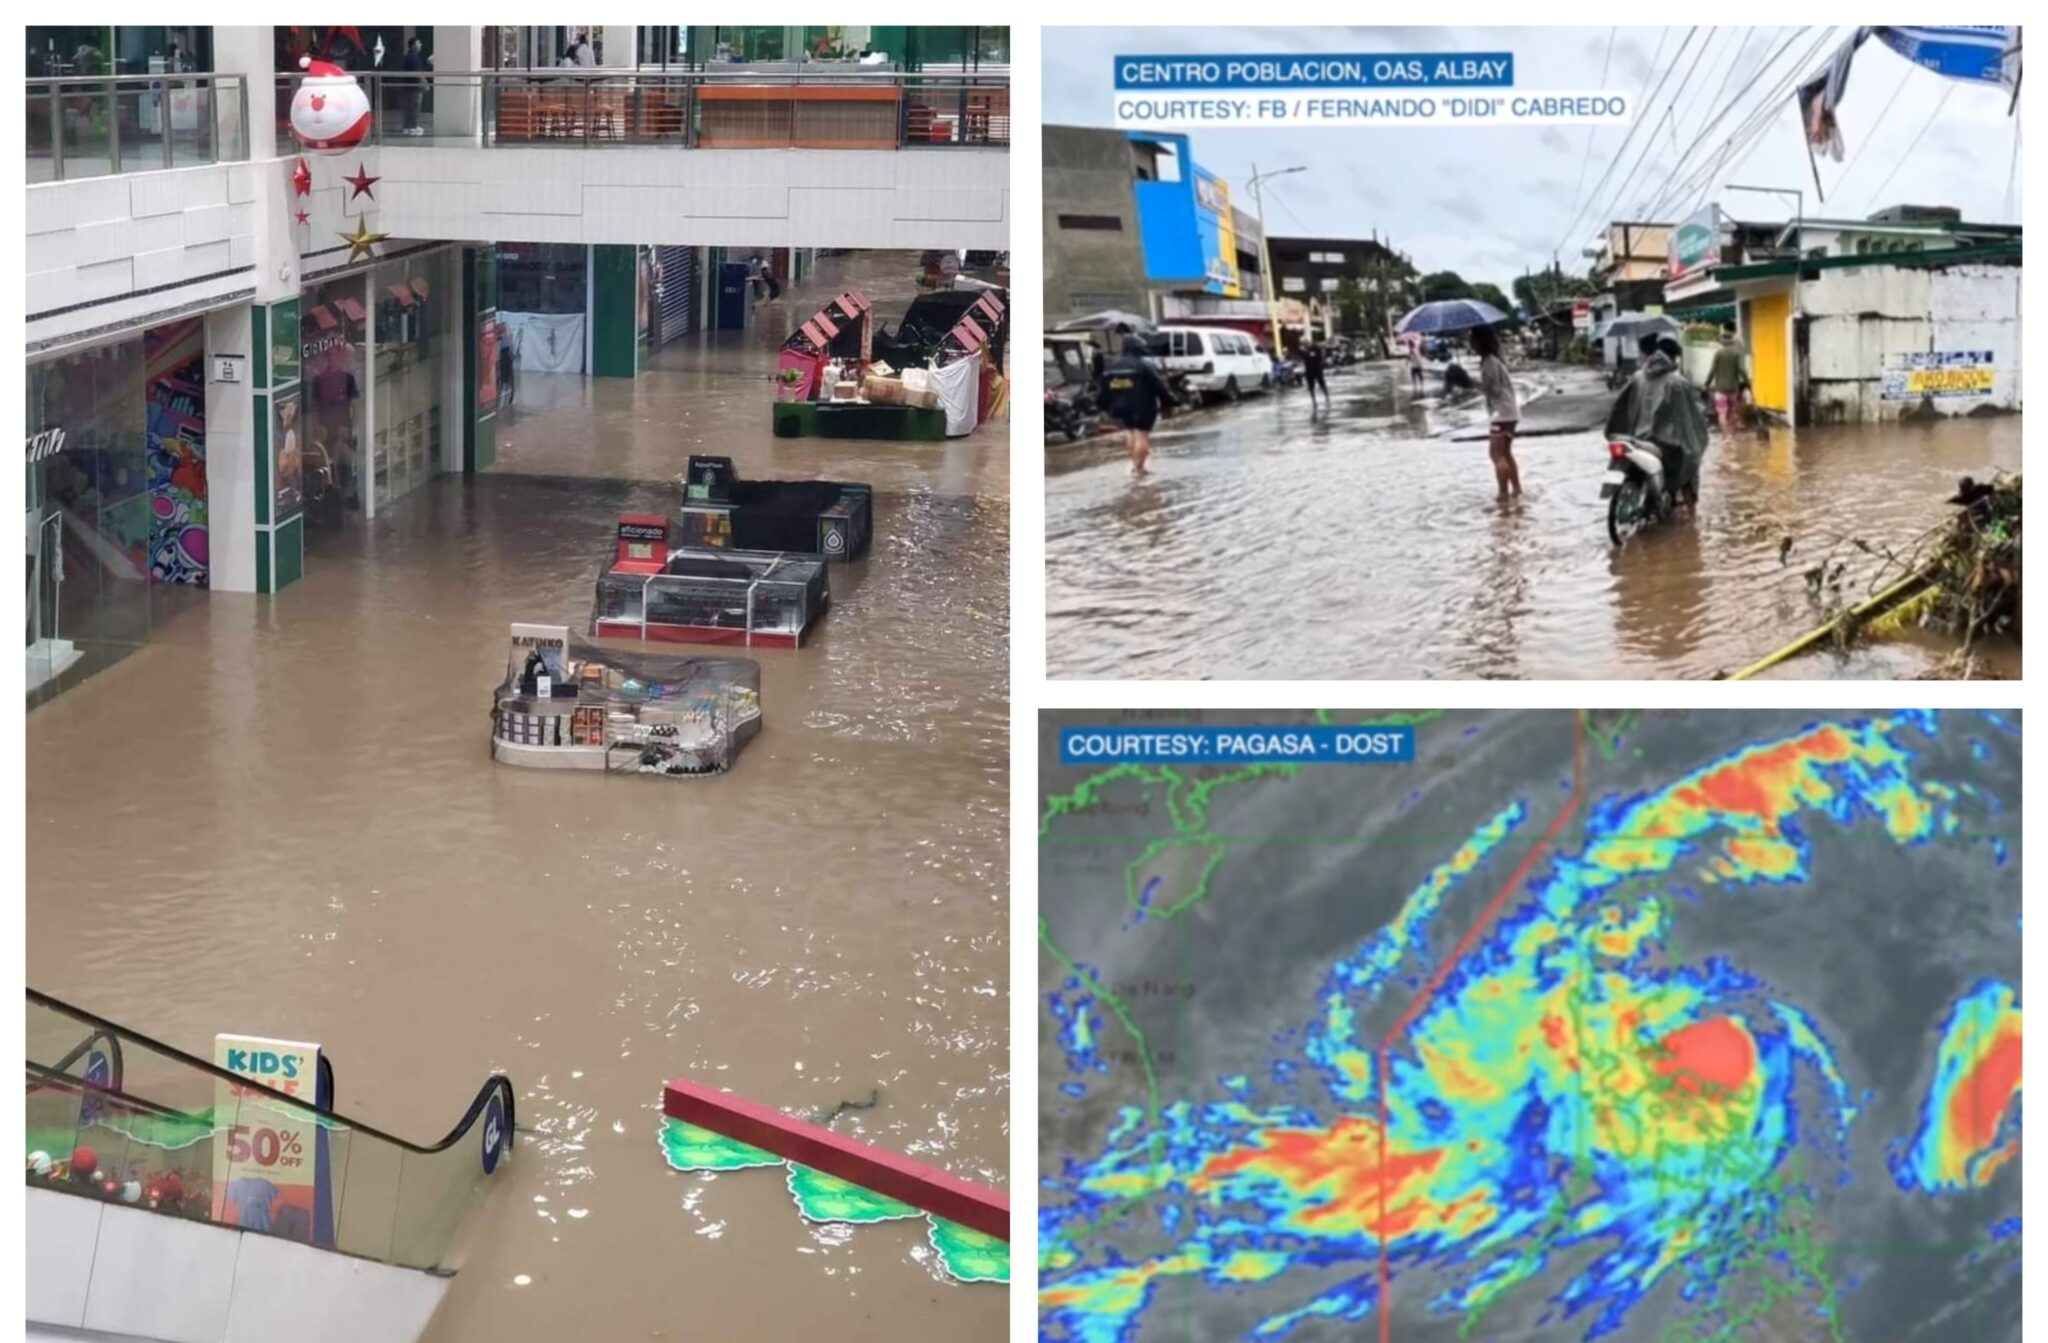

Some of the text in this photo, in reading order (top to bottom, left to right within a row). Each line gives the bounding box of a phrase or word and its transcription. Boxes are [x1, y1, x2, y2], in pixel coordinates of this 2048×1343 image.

[227, 1049, 304, 1078] KIDS'
[226, 1124, 303, 1167] 50%
[280, 1156, 304, 1168] OFF
